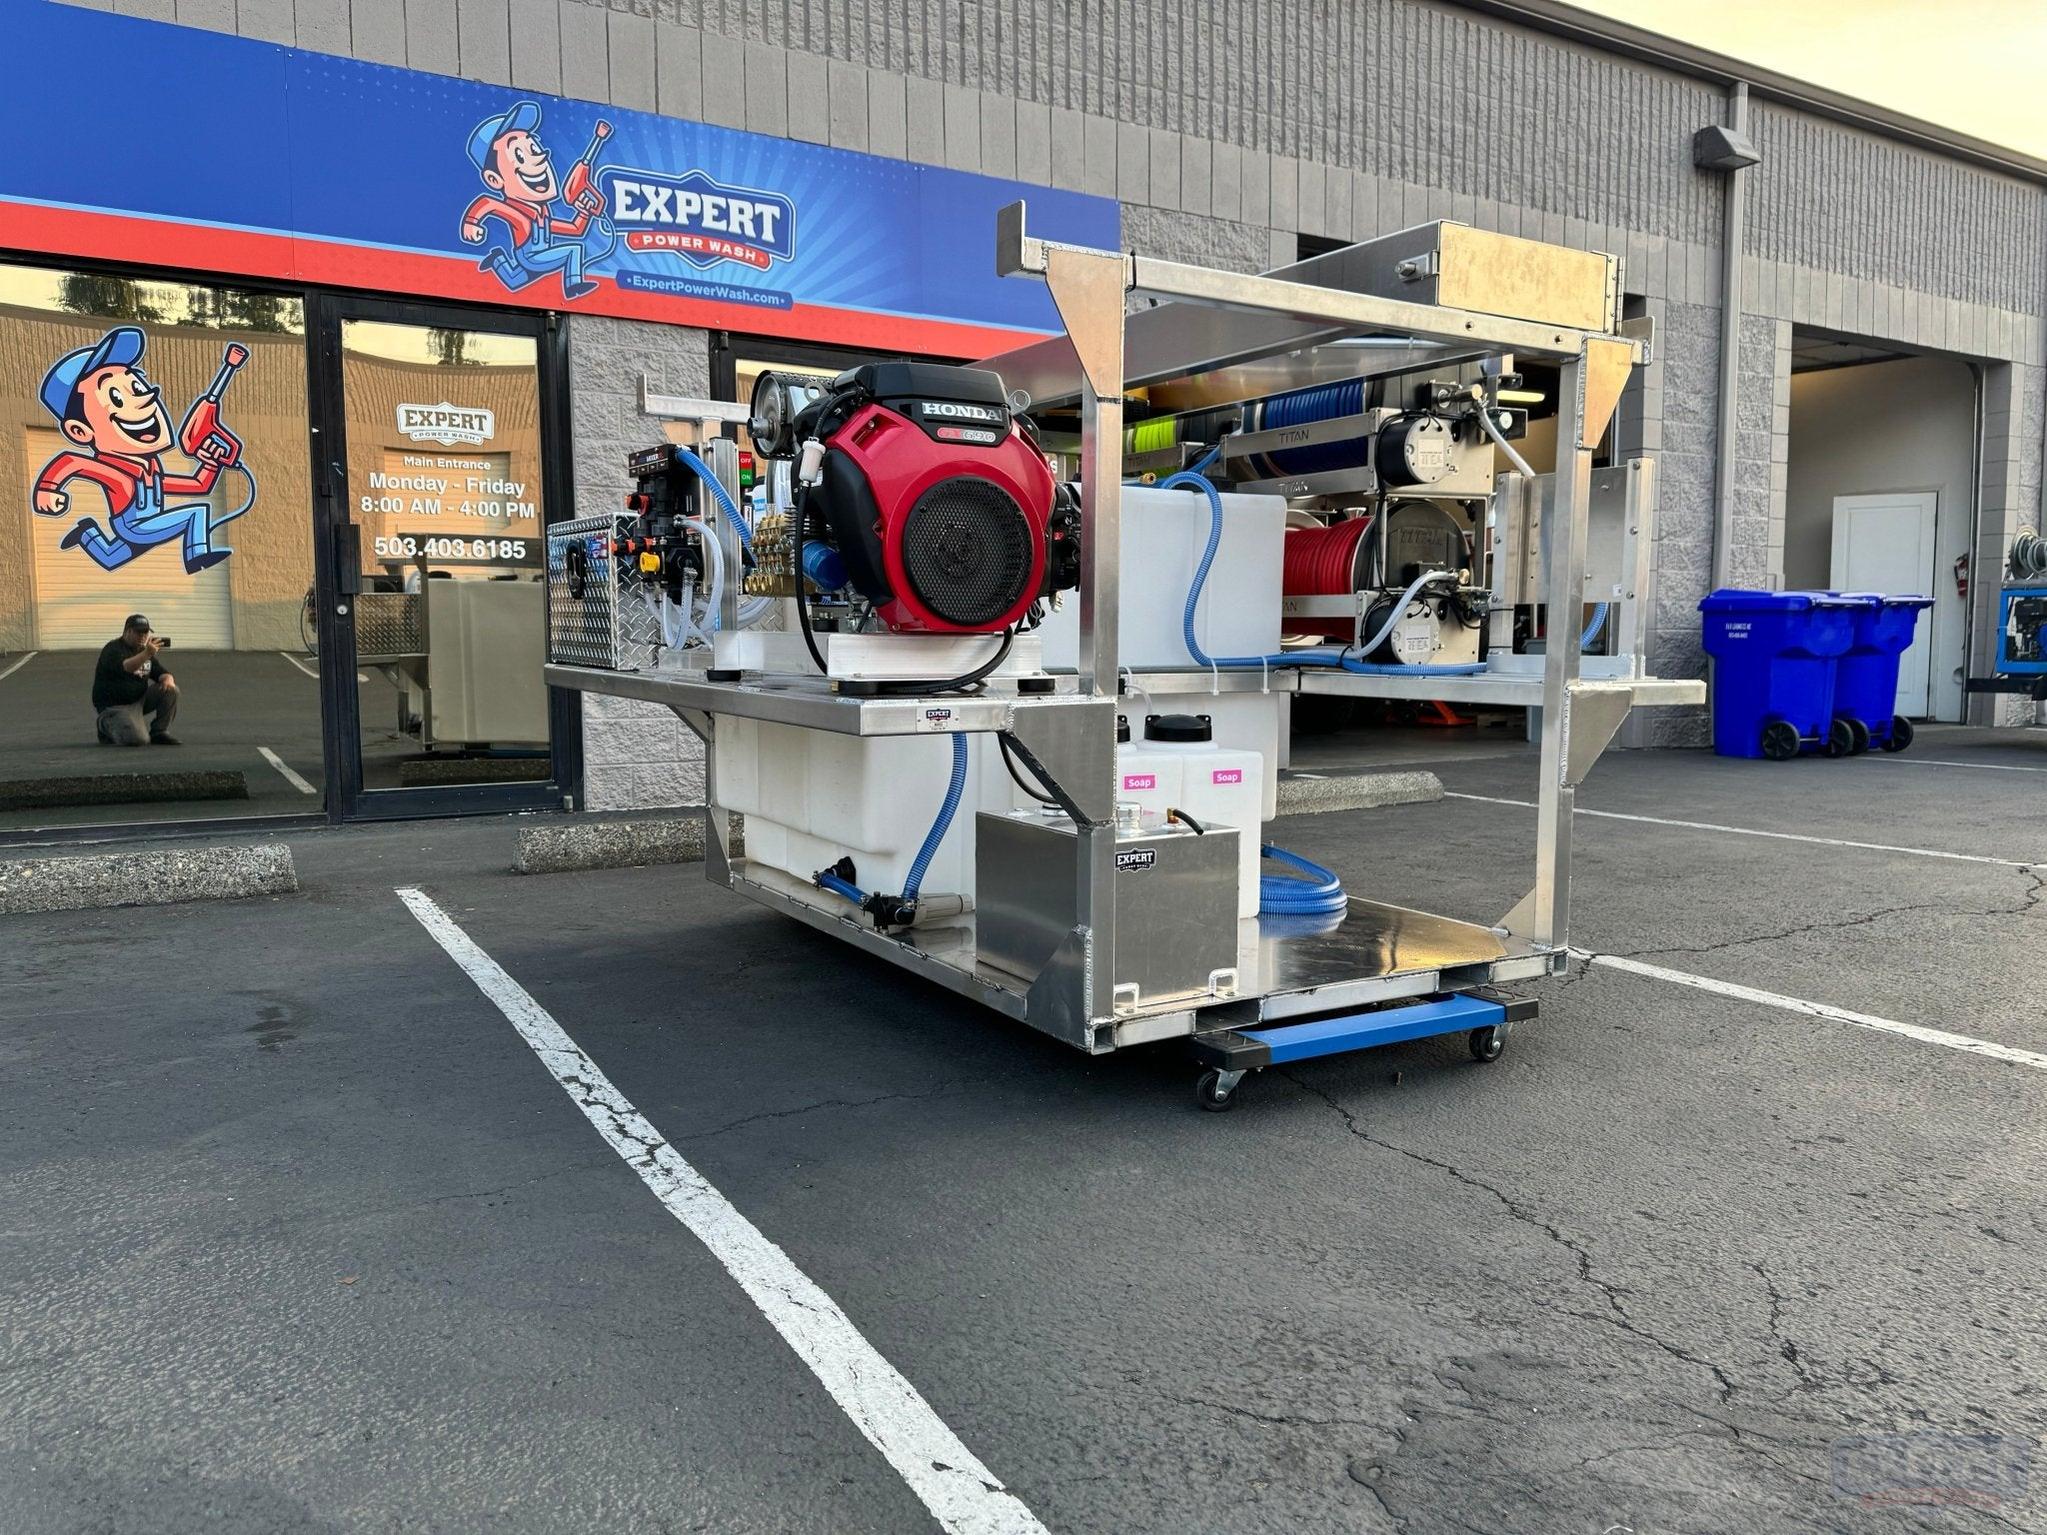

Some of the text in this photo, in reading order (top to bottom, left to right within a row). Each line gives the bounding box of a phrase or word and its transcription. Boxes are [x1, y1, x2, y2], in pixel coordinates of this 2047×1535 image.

[612, 179, 781, 244] EXPERT
[642, 235, 757, 262] POWER WASH
[404, 409, 487, 431] EXPERT
[921, 402, 1001, 421] HONDA
[451, 432, 476, 441] WASH
[404, 456, 492, 471] Main Entrance
[369, 472, 448, 496] Monday
[466, 477, 526, 500] Friday
[361, 496, 404, 513] 8:00
[410, 498, 442, 515] AM
[459, 501, 501, 518] 4:00
[506, 502, 535, 519] PM
[374, 537, 526, 559] 503.403.6185
[1128, 778, 1151, 788] Soap
[1217, 772, 1238, 783] Soap
[1117, 852, 1153, 865] EXPERT
